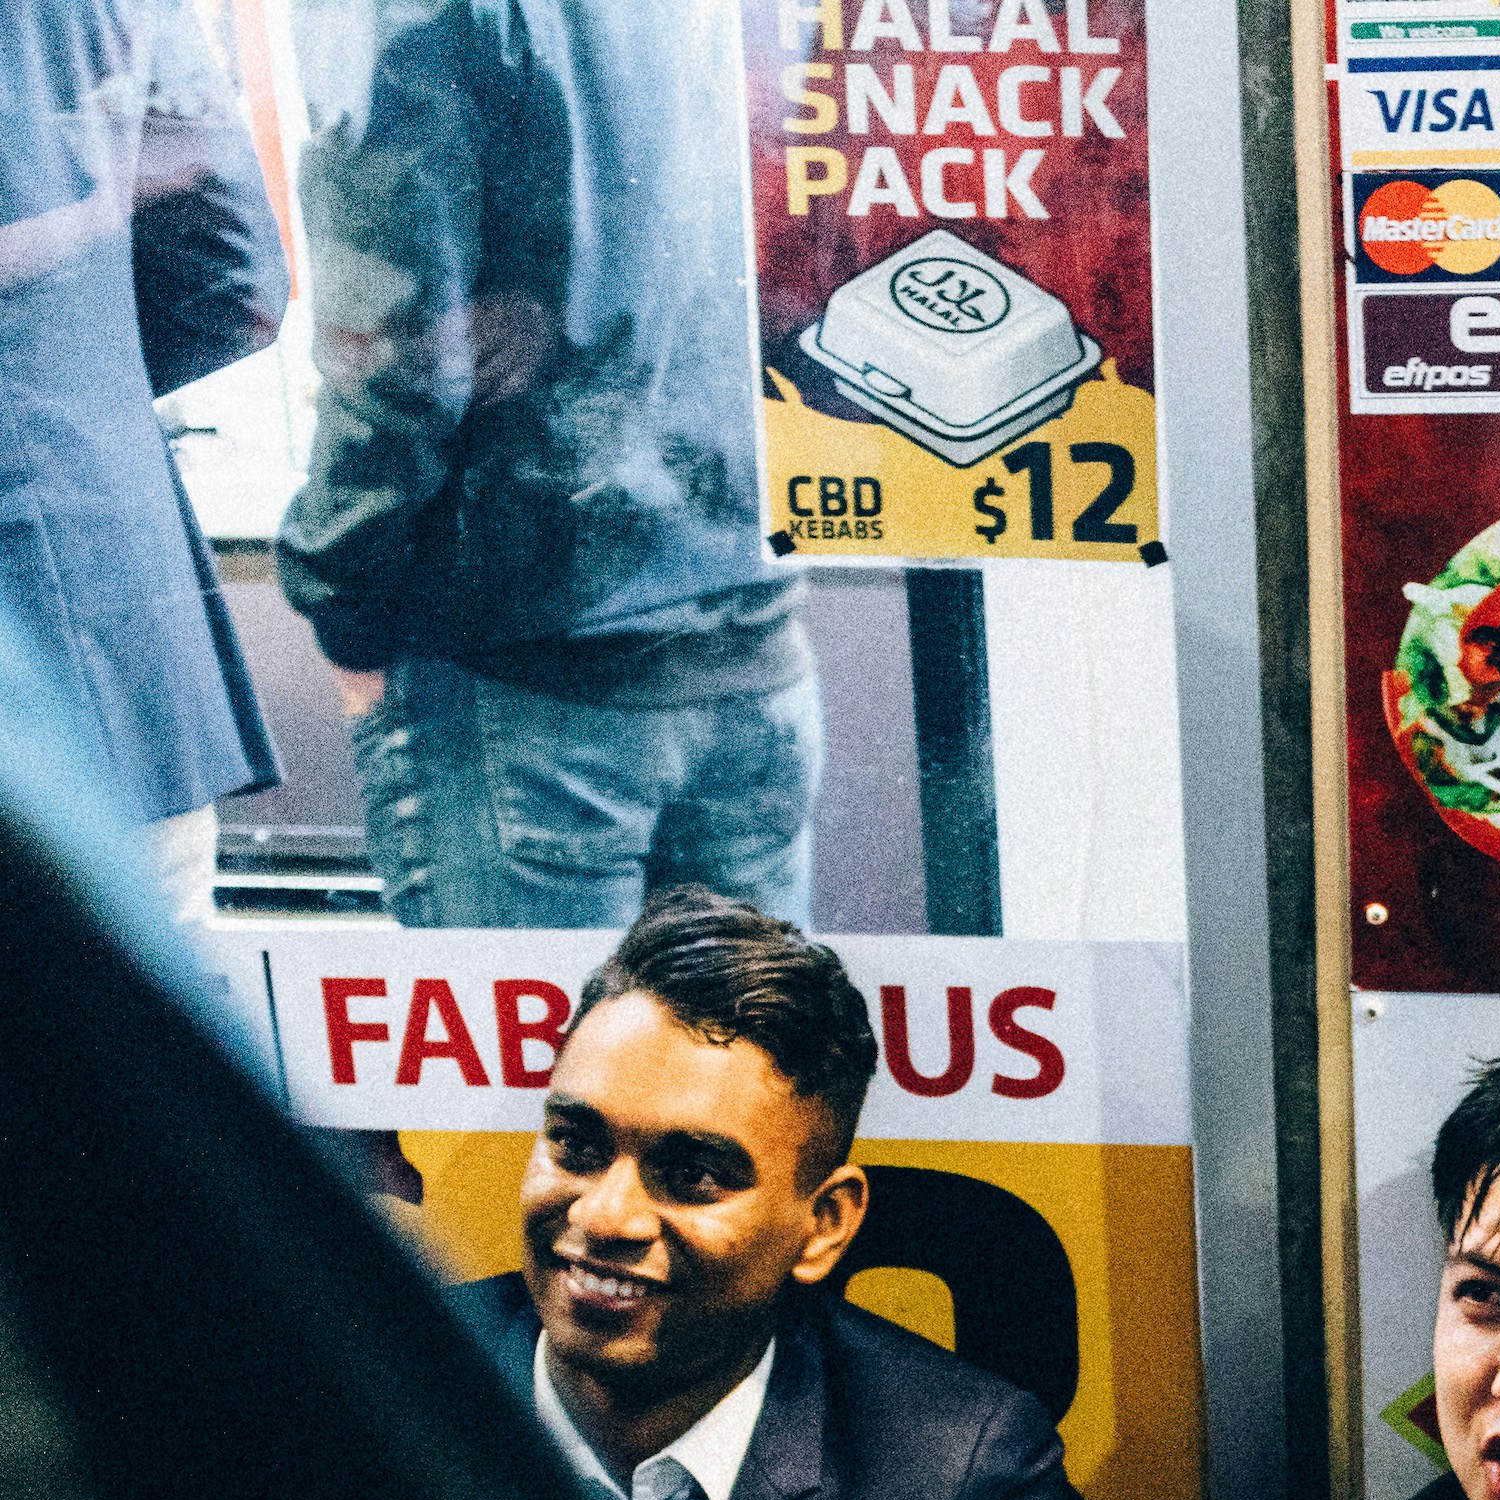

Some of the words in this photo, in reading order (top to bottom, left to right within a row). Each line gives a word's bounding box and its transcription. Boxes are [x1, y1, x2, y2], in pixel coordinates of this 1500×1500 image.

[777, 0, 1119, 53] HALAL
[780, 63, 1126, 139] SNACK
[1366, 88, 1494, 133] VISA
[786, 145, 1050, 219] PACK
[900, 285, 960, 327] HALAL
[1382, 357, 1491, 391] eftpos
[788, 476, 882, 517] CBD
[973, 441, 1138, 544] $12
[789, 520, 884, 540] KEBABS
[320, 977, 1067, 1100] FABUS
